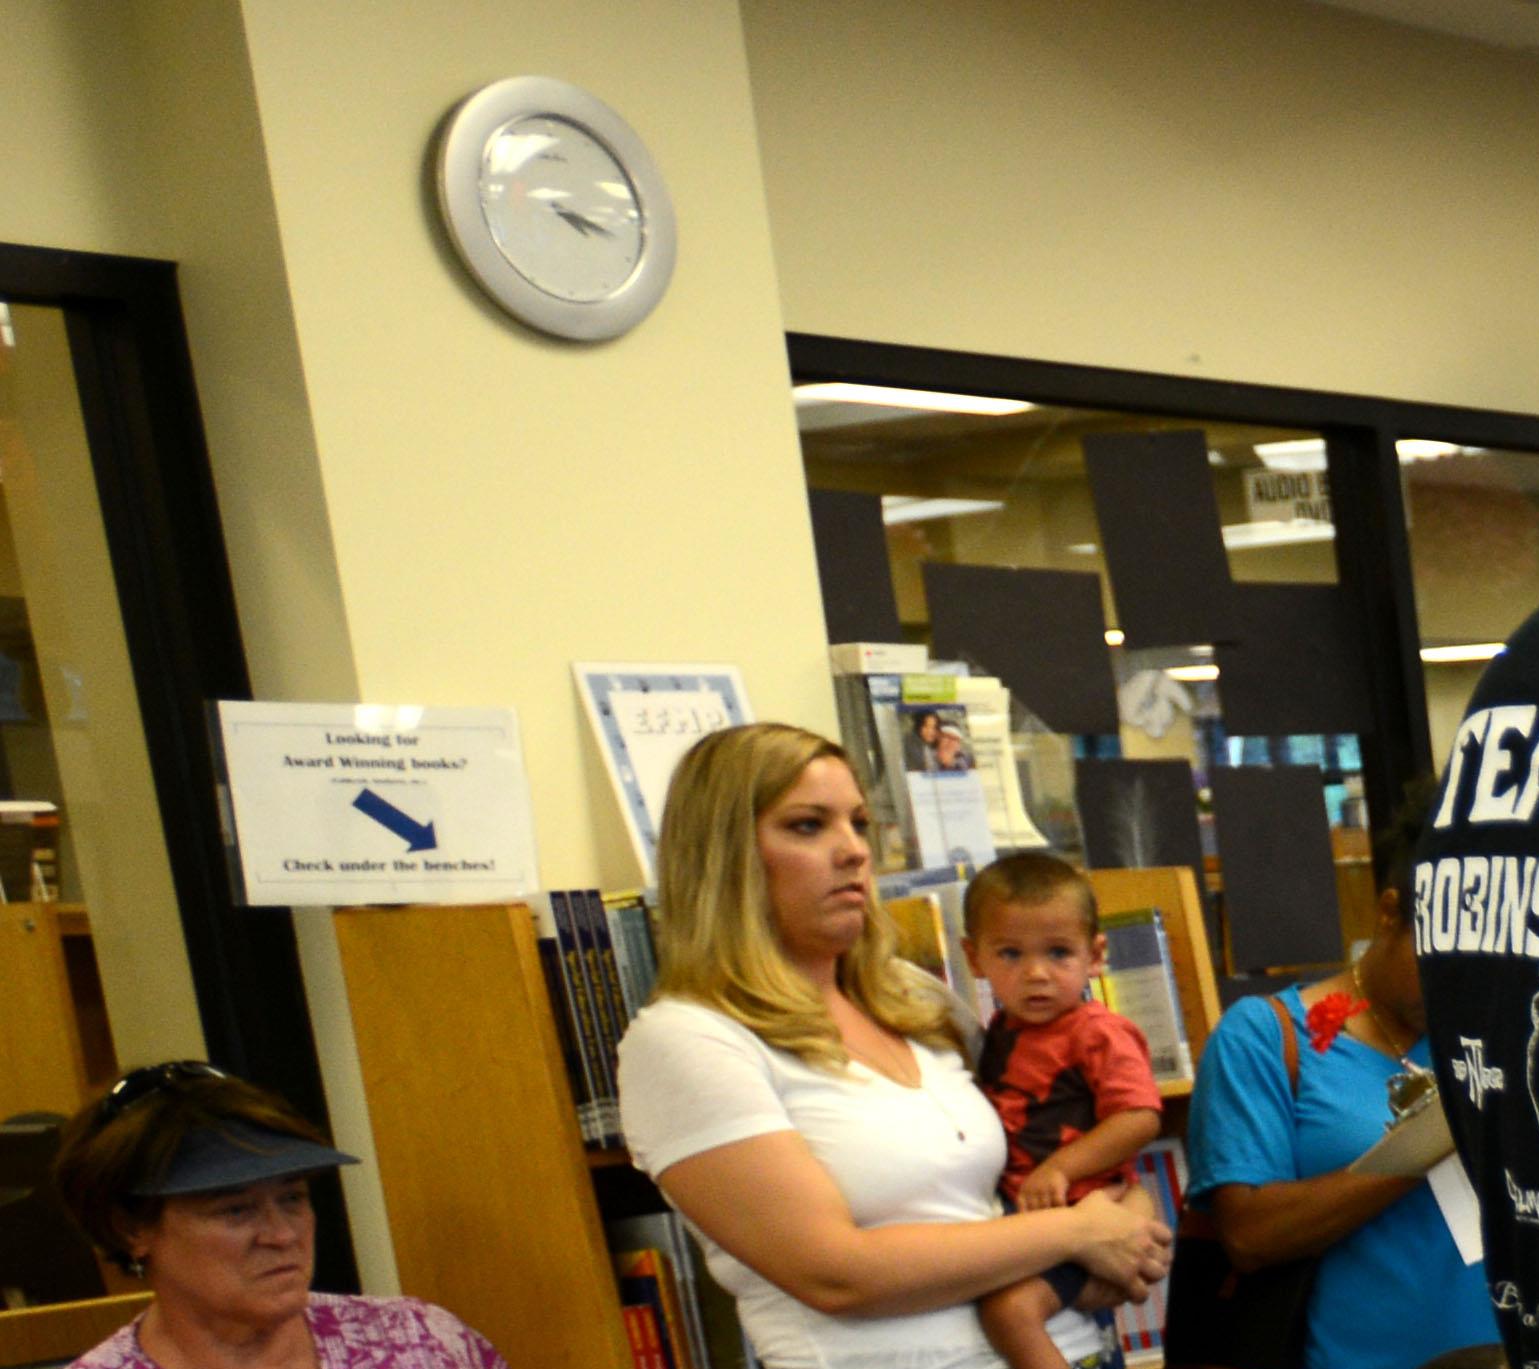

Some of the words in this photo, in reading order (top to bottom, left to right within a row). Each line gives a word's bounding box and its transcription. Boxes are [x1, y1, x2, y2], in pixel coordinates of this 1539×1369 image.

[325, 732, 391, 747] Looking
[396, 734, 420, 746] for
[283, 755, 334, 769] Award
[340, 756, 406, 771] Winning
[411, 757, 467, 770] books?
[283, 859, 335, 872] Check
[340, 860, 386, 872] under
[393, 860, 418, 872] the
[424, 860, 496, 872] benches!
